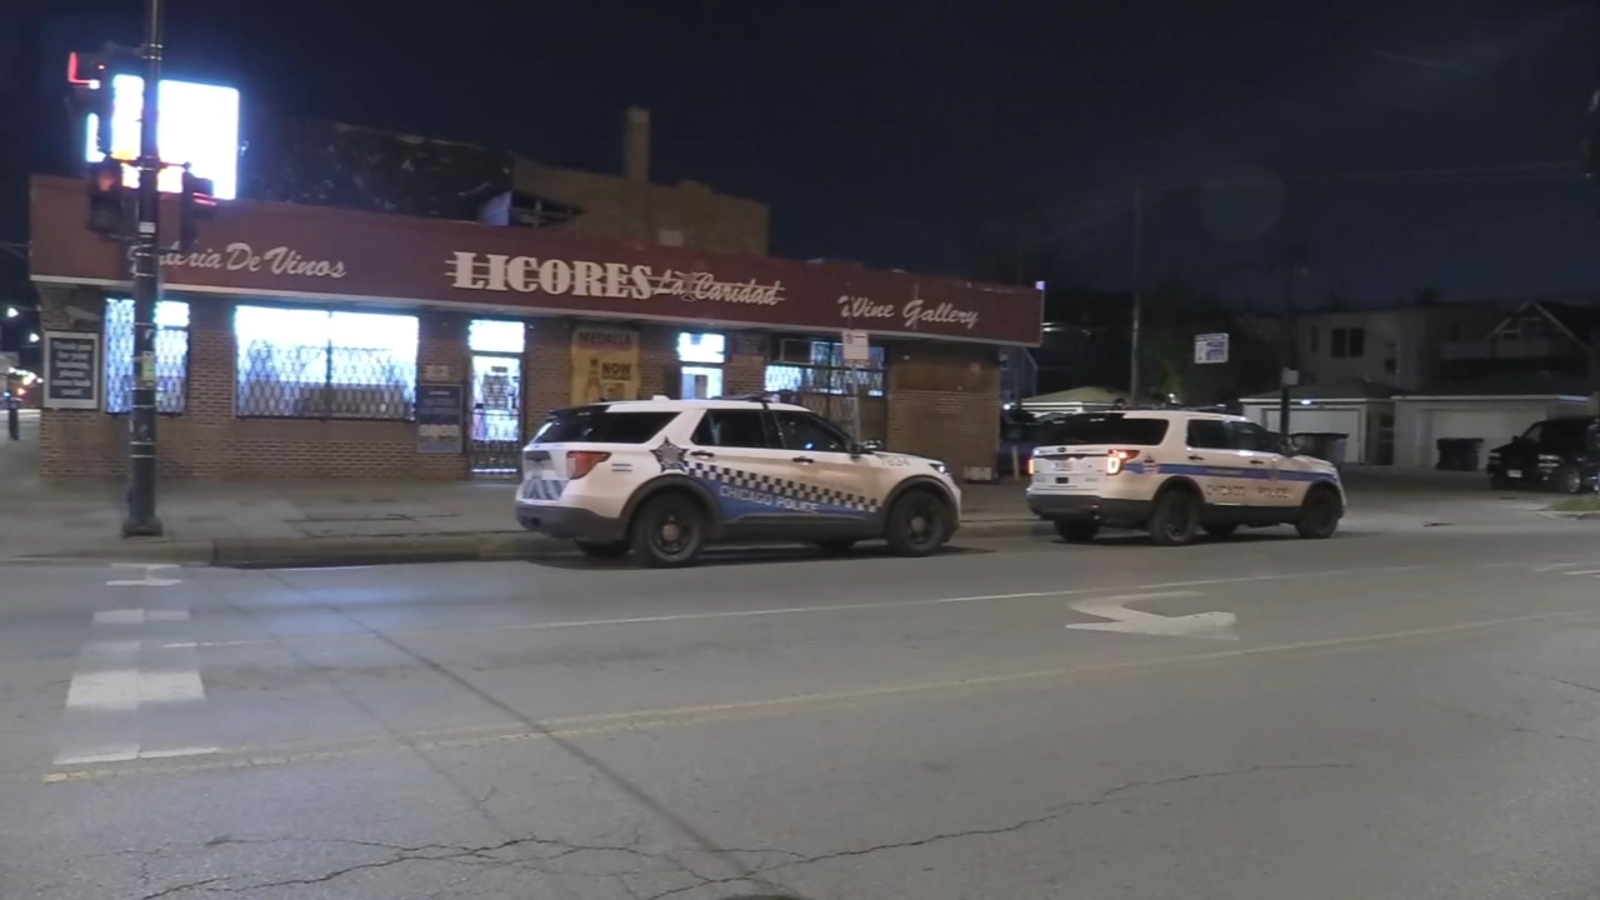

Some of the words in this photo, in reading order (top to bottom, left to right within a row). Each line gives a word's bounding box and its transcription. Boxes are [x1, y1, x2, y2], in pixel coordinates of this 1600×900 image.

[128, 241, 224, 277] leria
[225, 242, 261, 272] De
[263, 246, 348, 279] Vinos
[450, 250, 652, 300] LICORES
[653, 269, 684, 296] La
[694, 273, 782, 306] Caridad
[837, 295, 895, 318] Wine
[902, 299, 979, 329] Gallery
[601, 362, 632, 375] NOW
[720, 484, 773, 506] CHICAGO
[775, 495, 820, 512] POLICE
